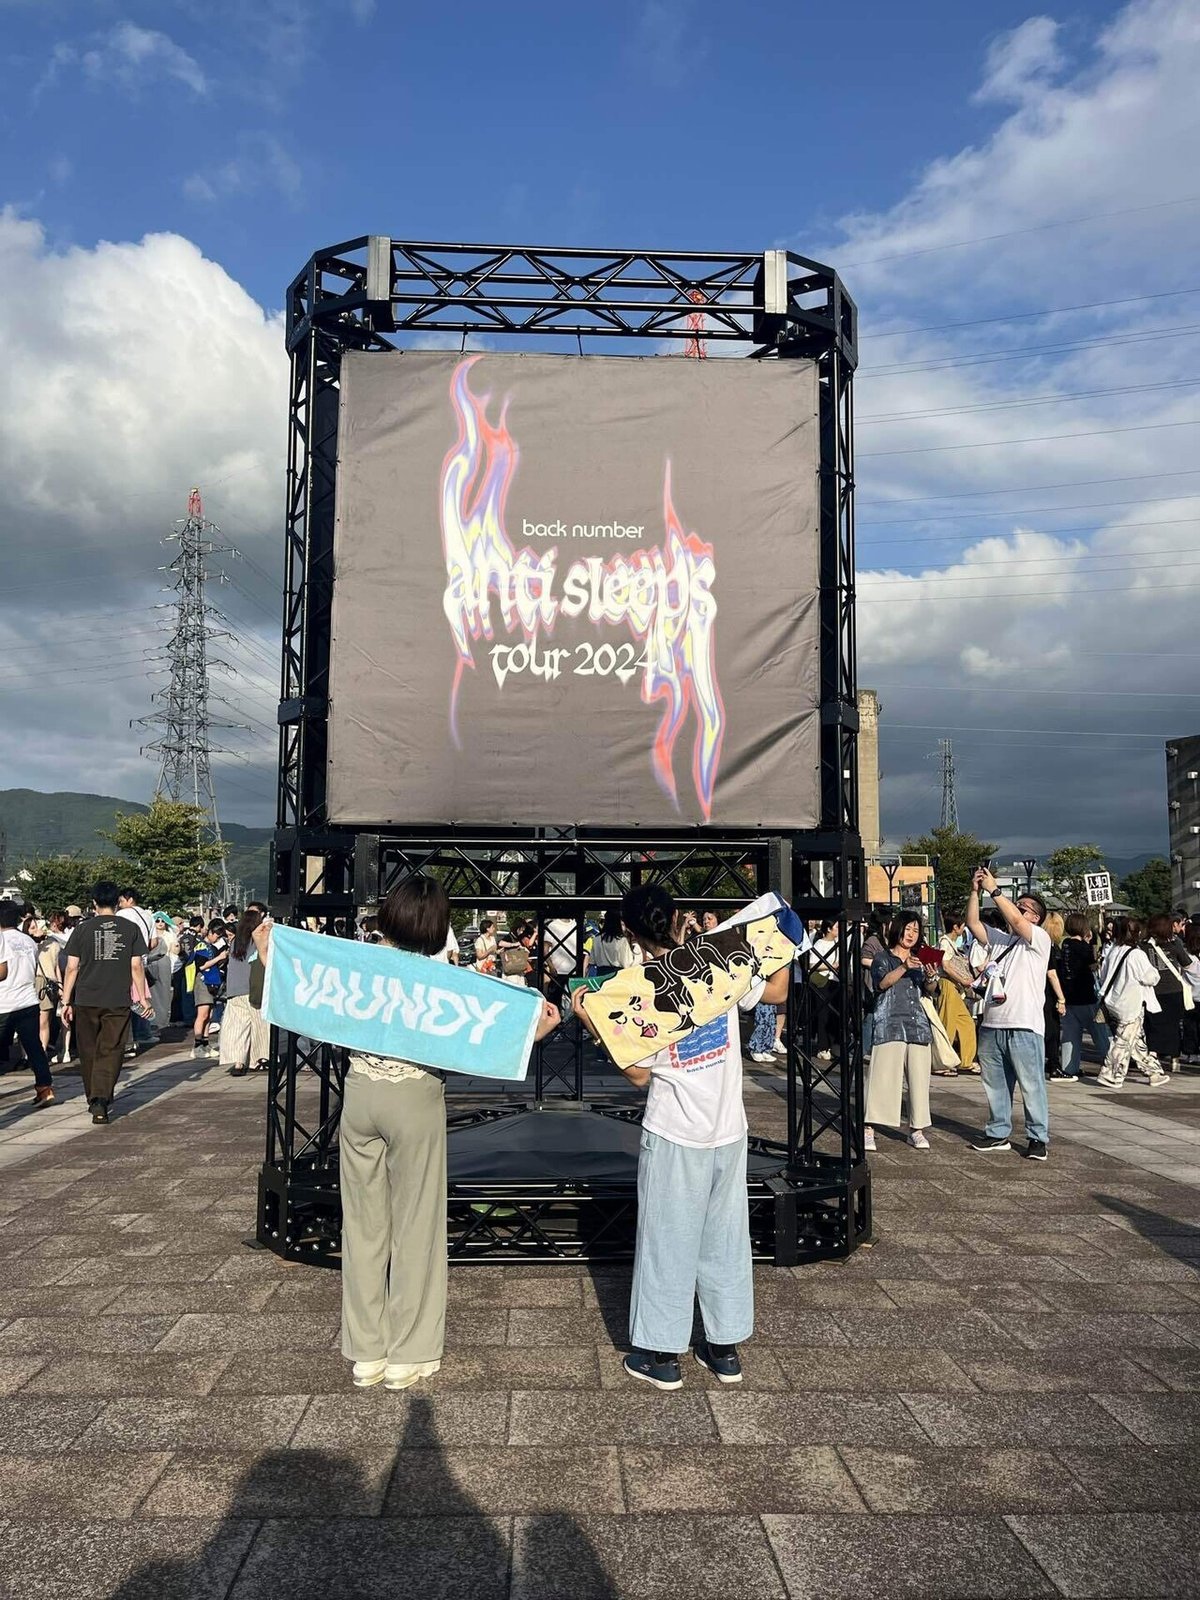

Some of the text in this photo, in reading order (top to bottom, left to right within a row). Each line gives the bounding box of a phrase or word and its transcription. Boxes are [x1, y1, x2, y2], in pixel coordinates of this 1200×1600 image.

[522, 519, 644, 538] back number
[488, 634, 657, 690] tour 2024
[293, 957, 508, 1045] VAUNDY
